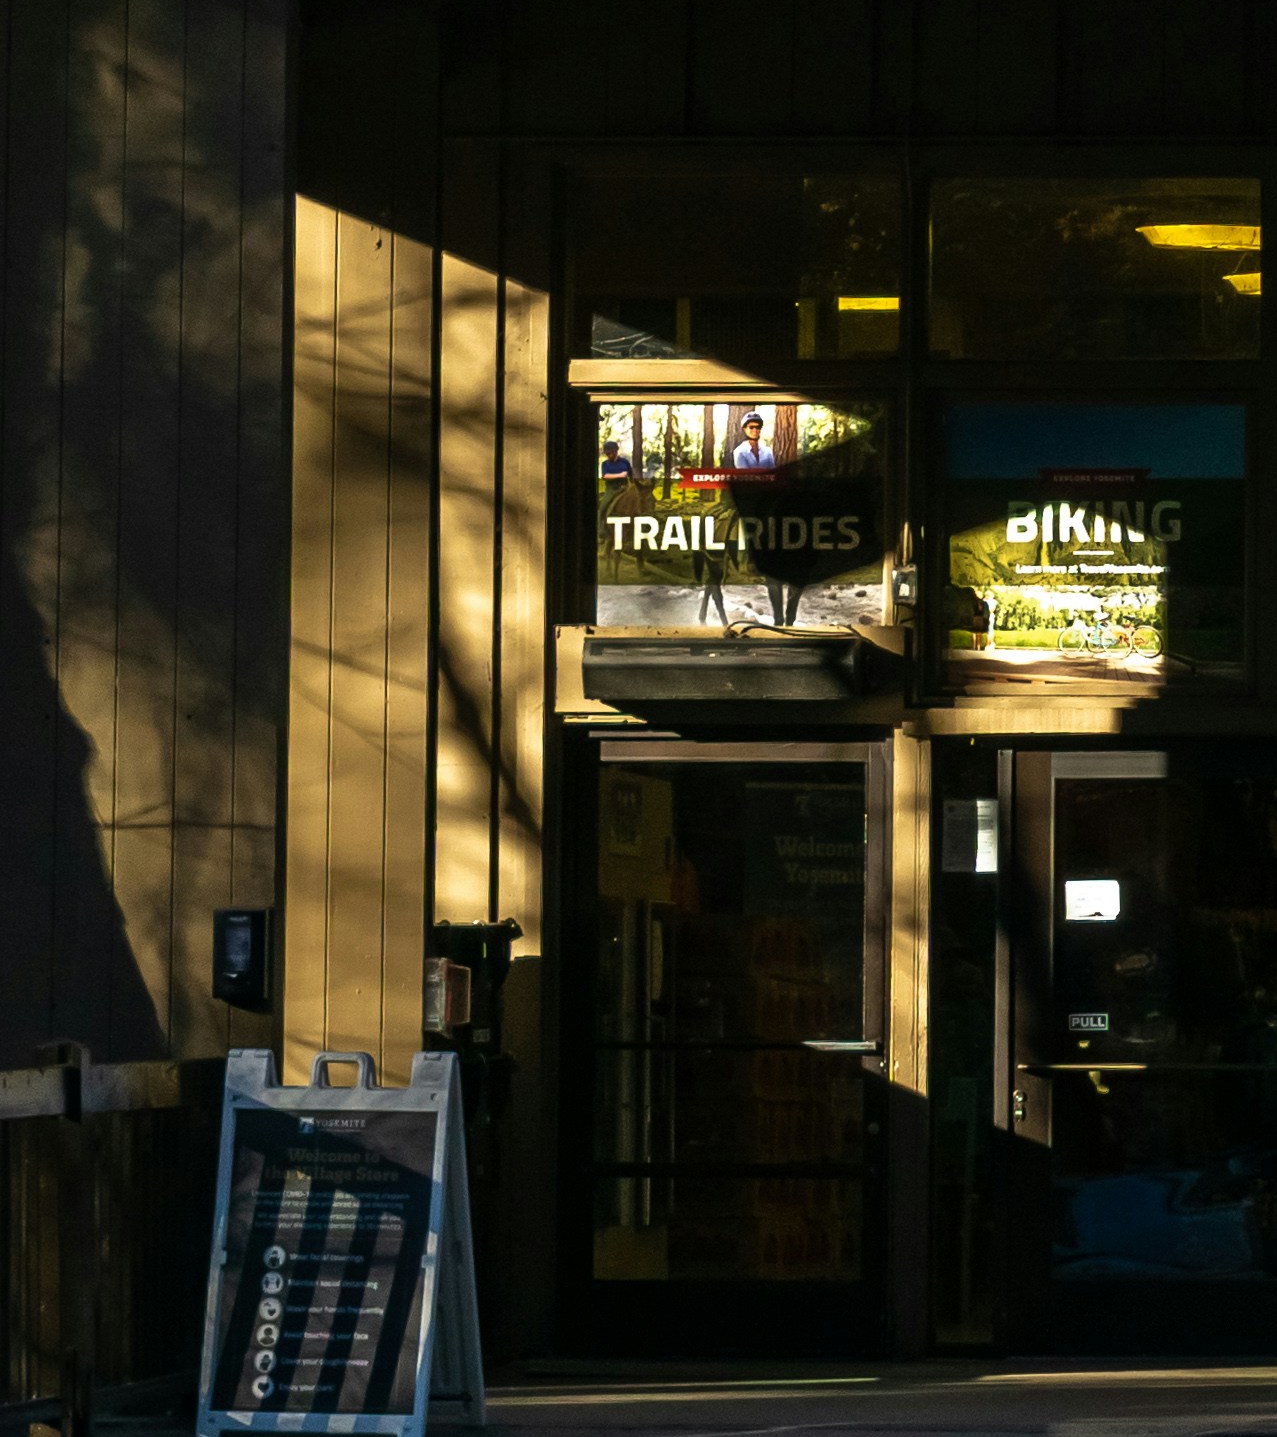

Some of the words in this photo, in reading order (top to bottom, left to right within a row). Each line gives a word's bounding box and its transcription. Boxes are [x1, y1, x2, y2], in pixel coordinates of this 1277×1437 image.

[692, 473, 731, 482] EXPLORE
[732, 473, 776, 482] YOSEMITE
[1053, 474, 1091, 482] EXPLORE
[1093, 474, 1136, 482] YOSEMITE
[1005, 499, 1183, 544] BIKING
[606, 515, 726, 551] TRAIL
[737, 514, 861, 551] RIDES
[1071, 1016, 1106, 1028] PULL
[316, 1119, 366, 1128] YOSEMITE
[287, 1147, 362, 1163] Welcome
[364, 1148, 381, 1163] to
[355, 1166, 400, 1182] Store
